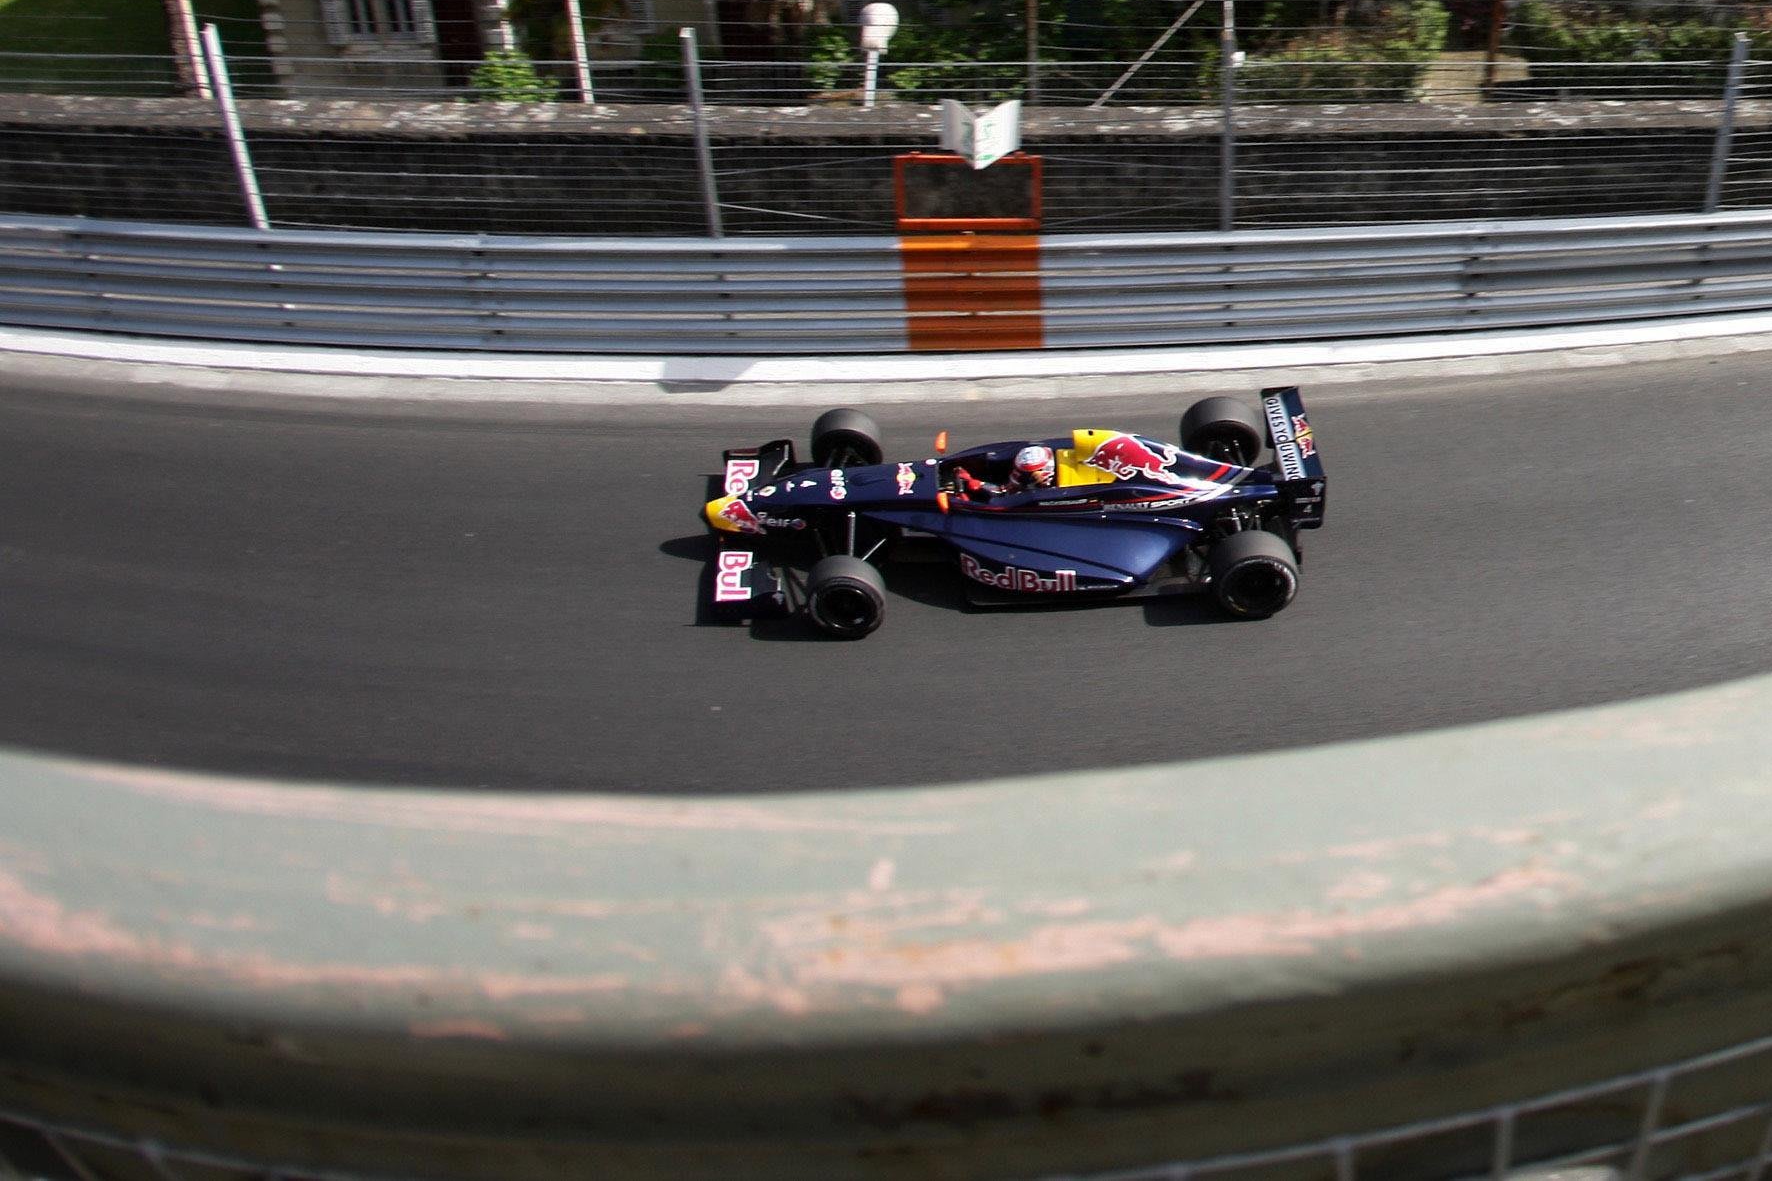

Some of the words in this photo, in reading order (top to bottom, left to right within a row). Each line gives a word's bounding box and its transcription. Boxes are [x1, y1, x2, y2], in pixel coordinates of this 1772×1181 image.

[1266, 398, 1286, 427] GIVES
[1274, 429, 1292, 452] YOU
[725, 460, 760, 495] Re
[716, 551, 753, 601] Bul
[959, 552, 1017, 590] Red
[1018, 570, 1077, 592] Bull
